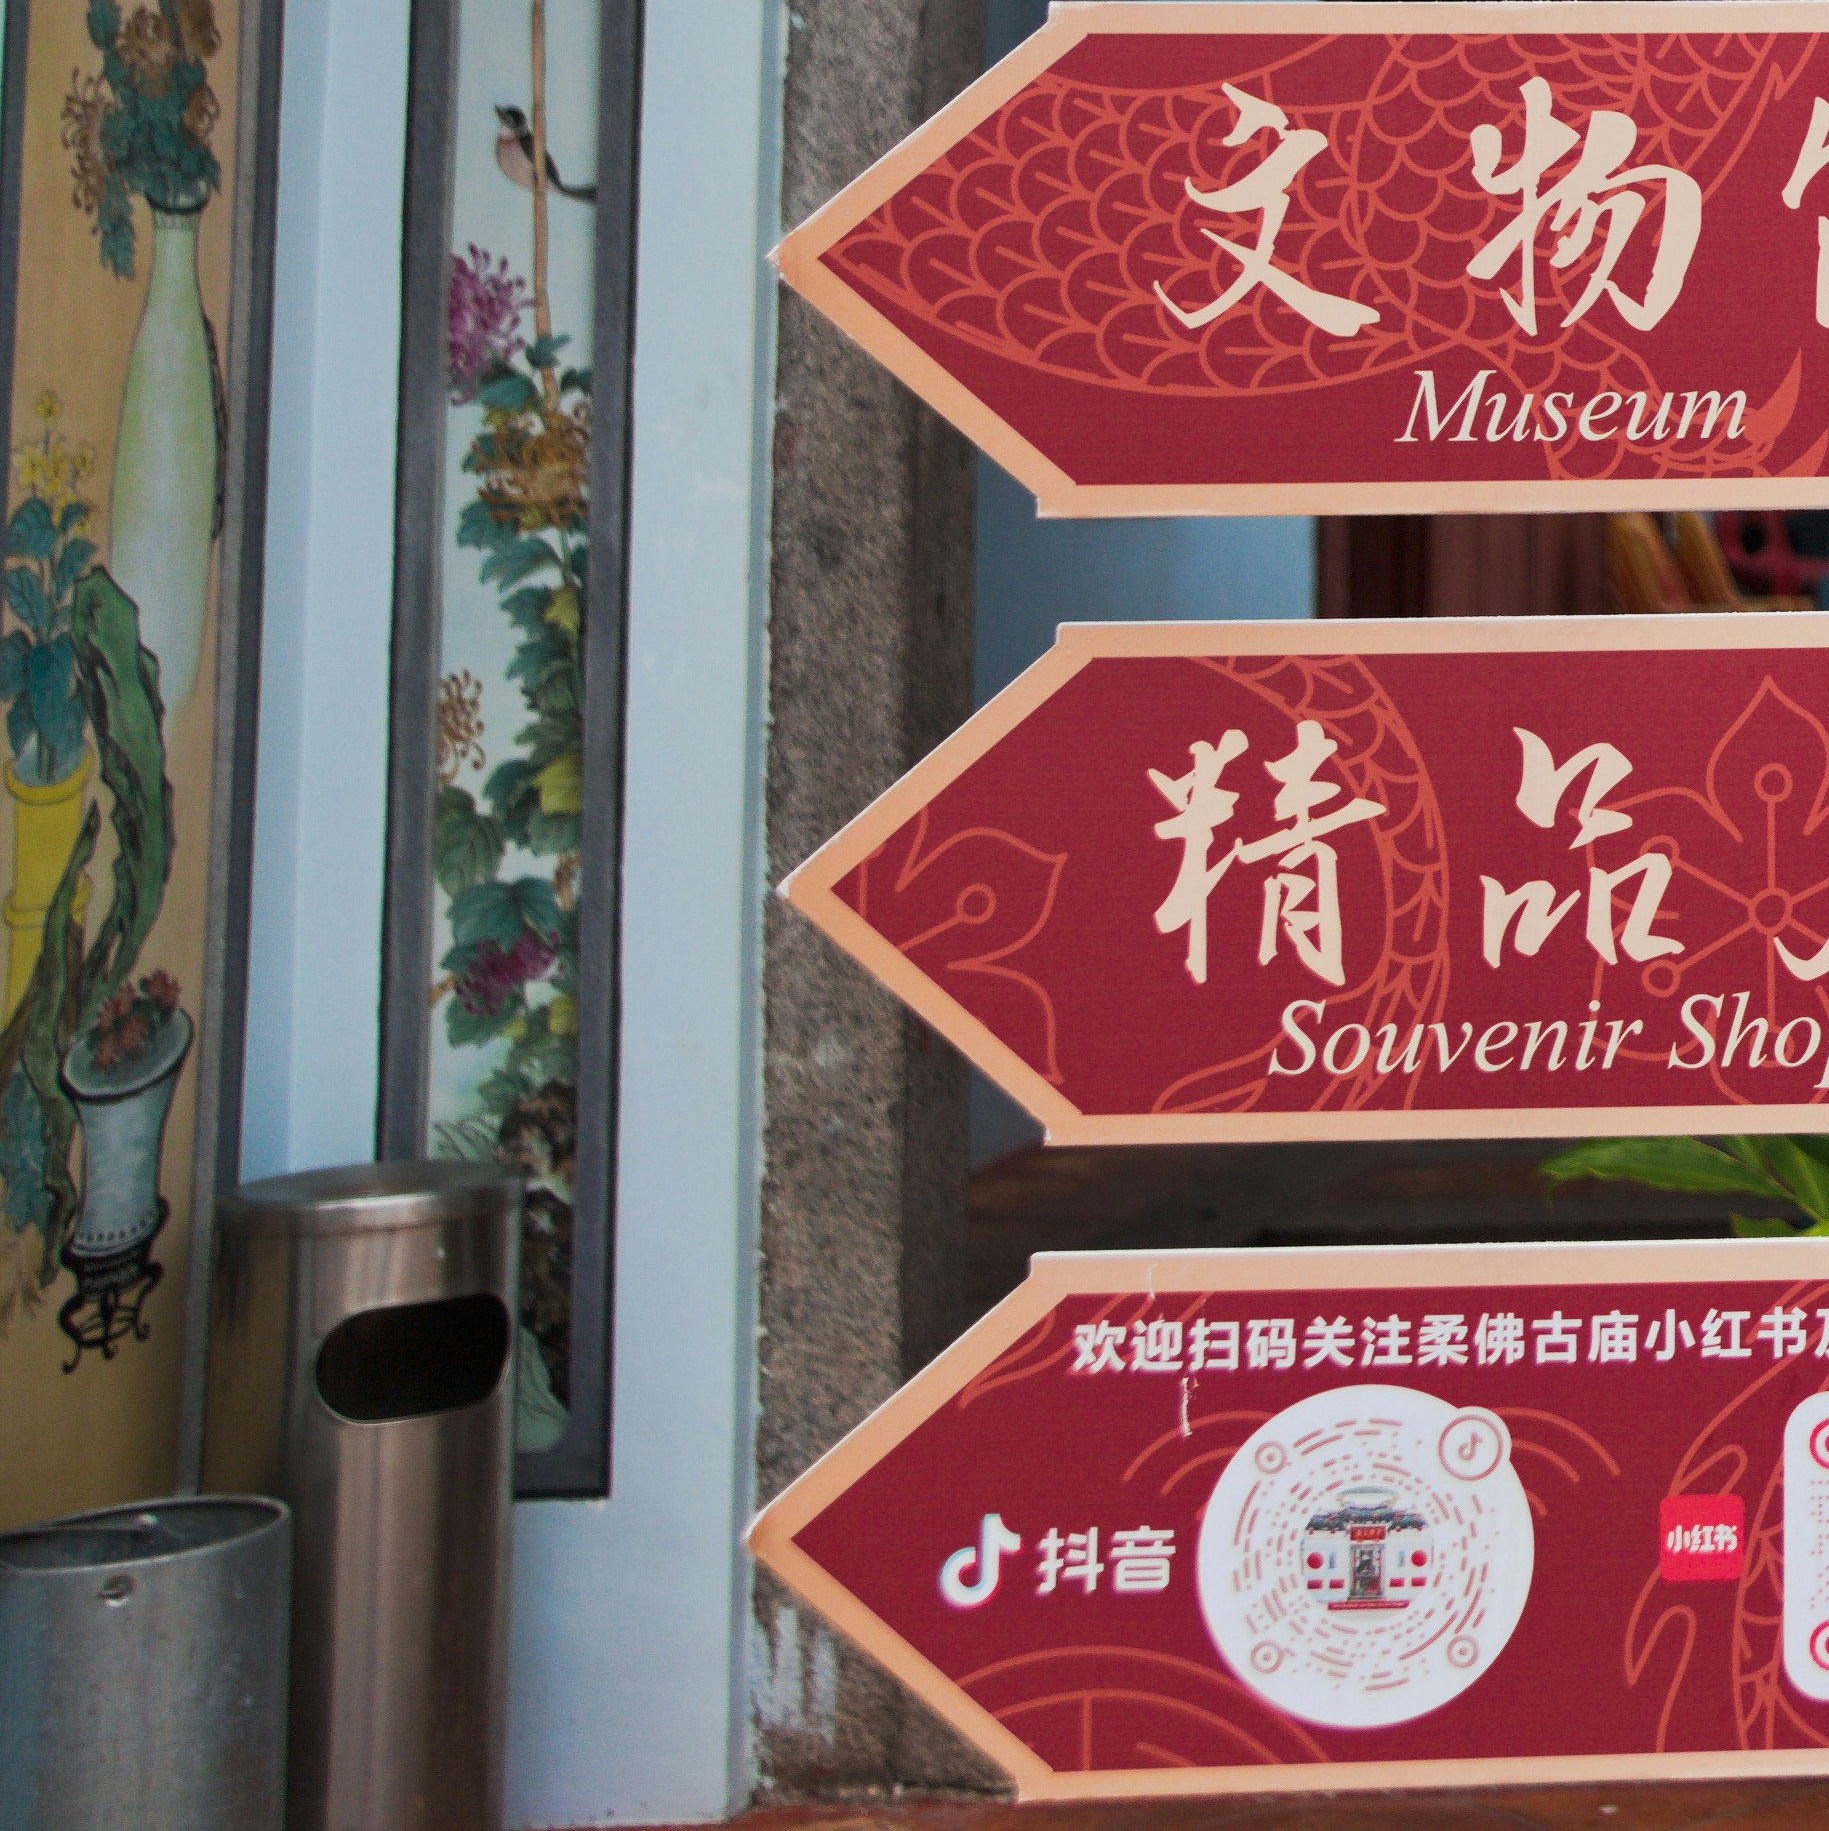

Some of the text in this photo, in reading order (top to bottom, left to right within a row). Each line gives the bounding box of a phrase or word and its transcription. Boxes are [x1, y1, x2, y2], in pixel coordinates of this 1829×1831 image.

[1395, 370, 1746, 443] Museum
[1268, 1000, 1643, 1076] Souvenir
[1038, 1526, 1176, 1593] 抖音
[1667, 1524, 1737, 1553] 小红书
